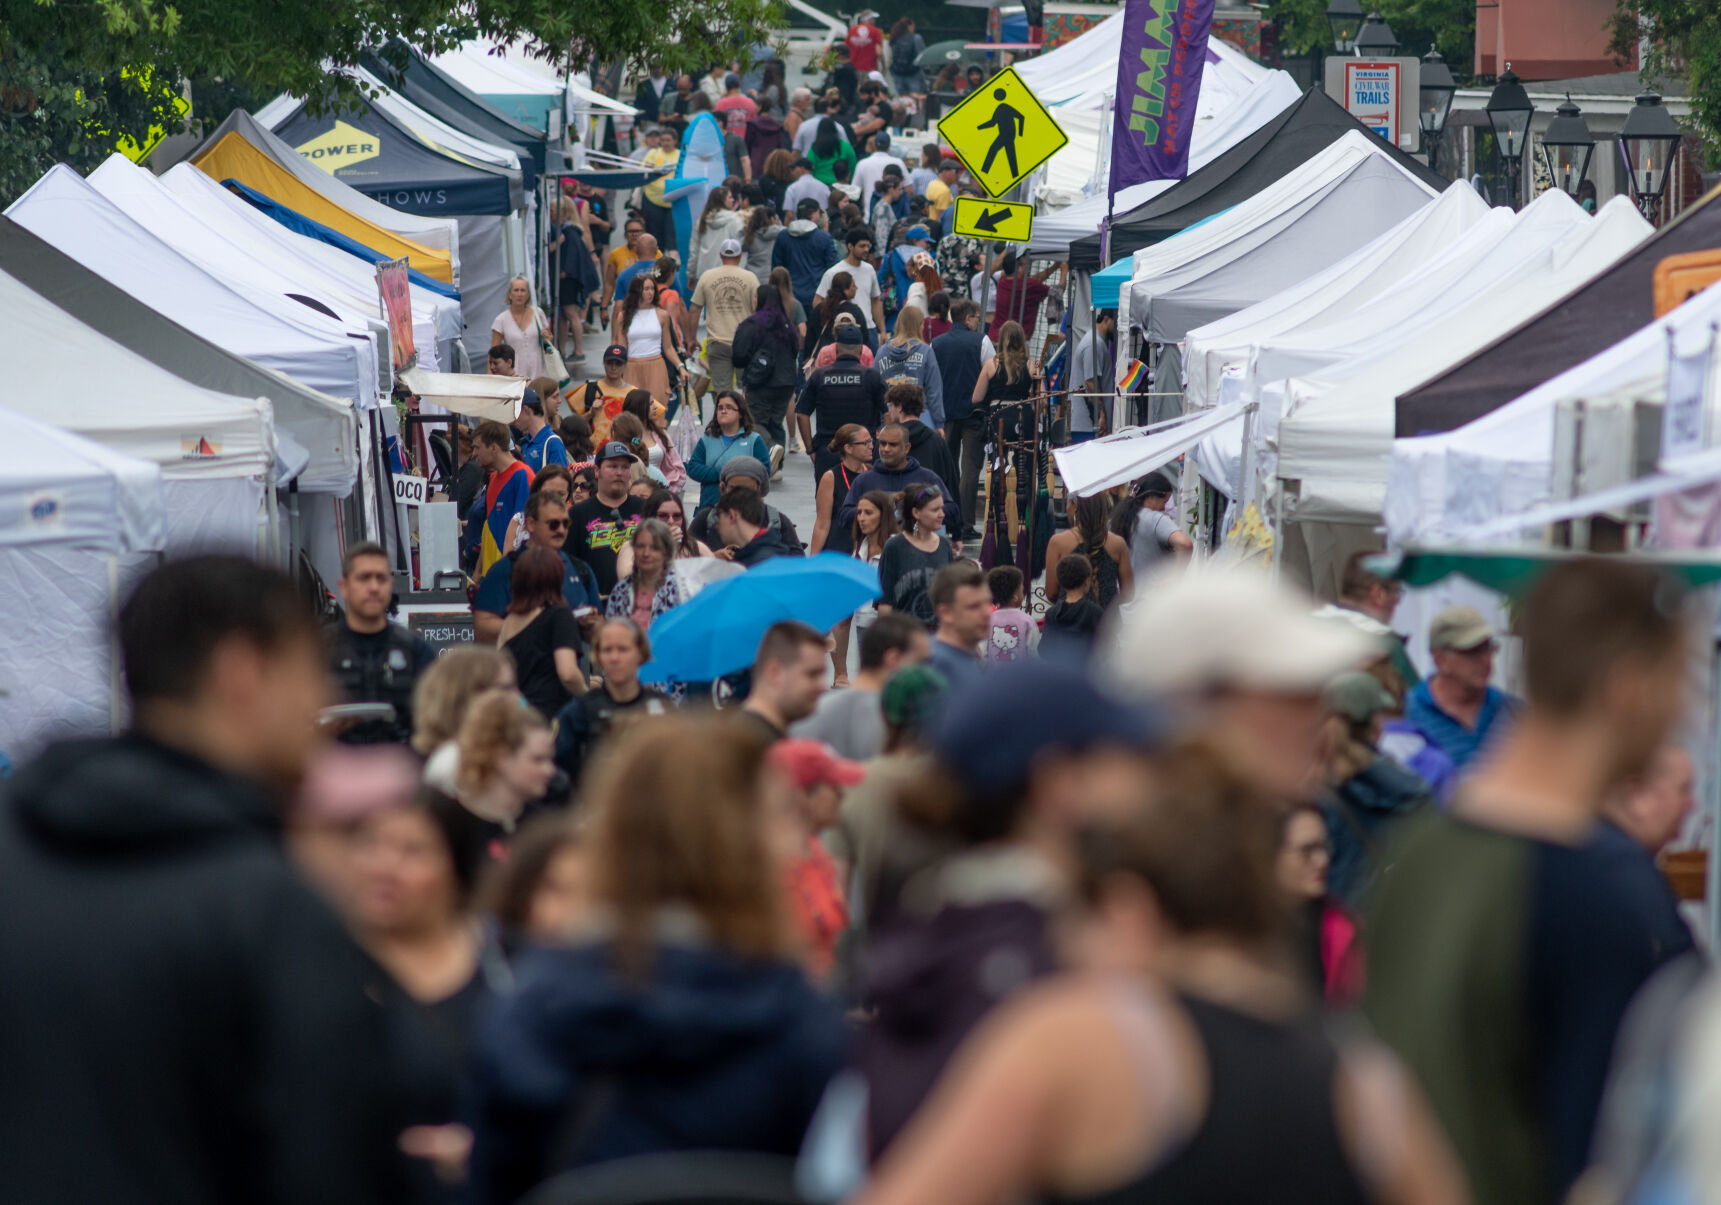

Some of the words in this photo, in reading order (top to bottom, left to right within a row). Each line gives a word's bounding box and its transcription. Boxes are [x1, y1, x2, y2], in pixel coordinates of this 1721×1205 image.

[1354, 81, 1374, 91] CIVIL
[1374, 81, 1390, 91] WAR
[1355, 91, 1390, 104] TRAILS
[1163, 82, 1182, 155] HATCH
[367, 189, 447, 205] HOWS
[823, 375, 861, 385] POLICE
